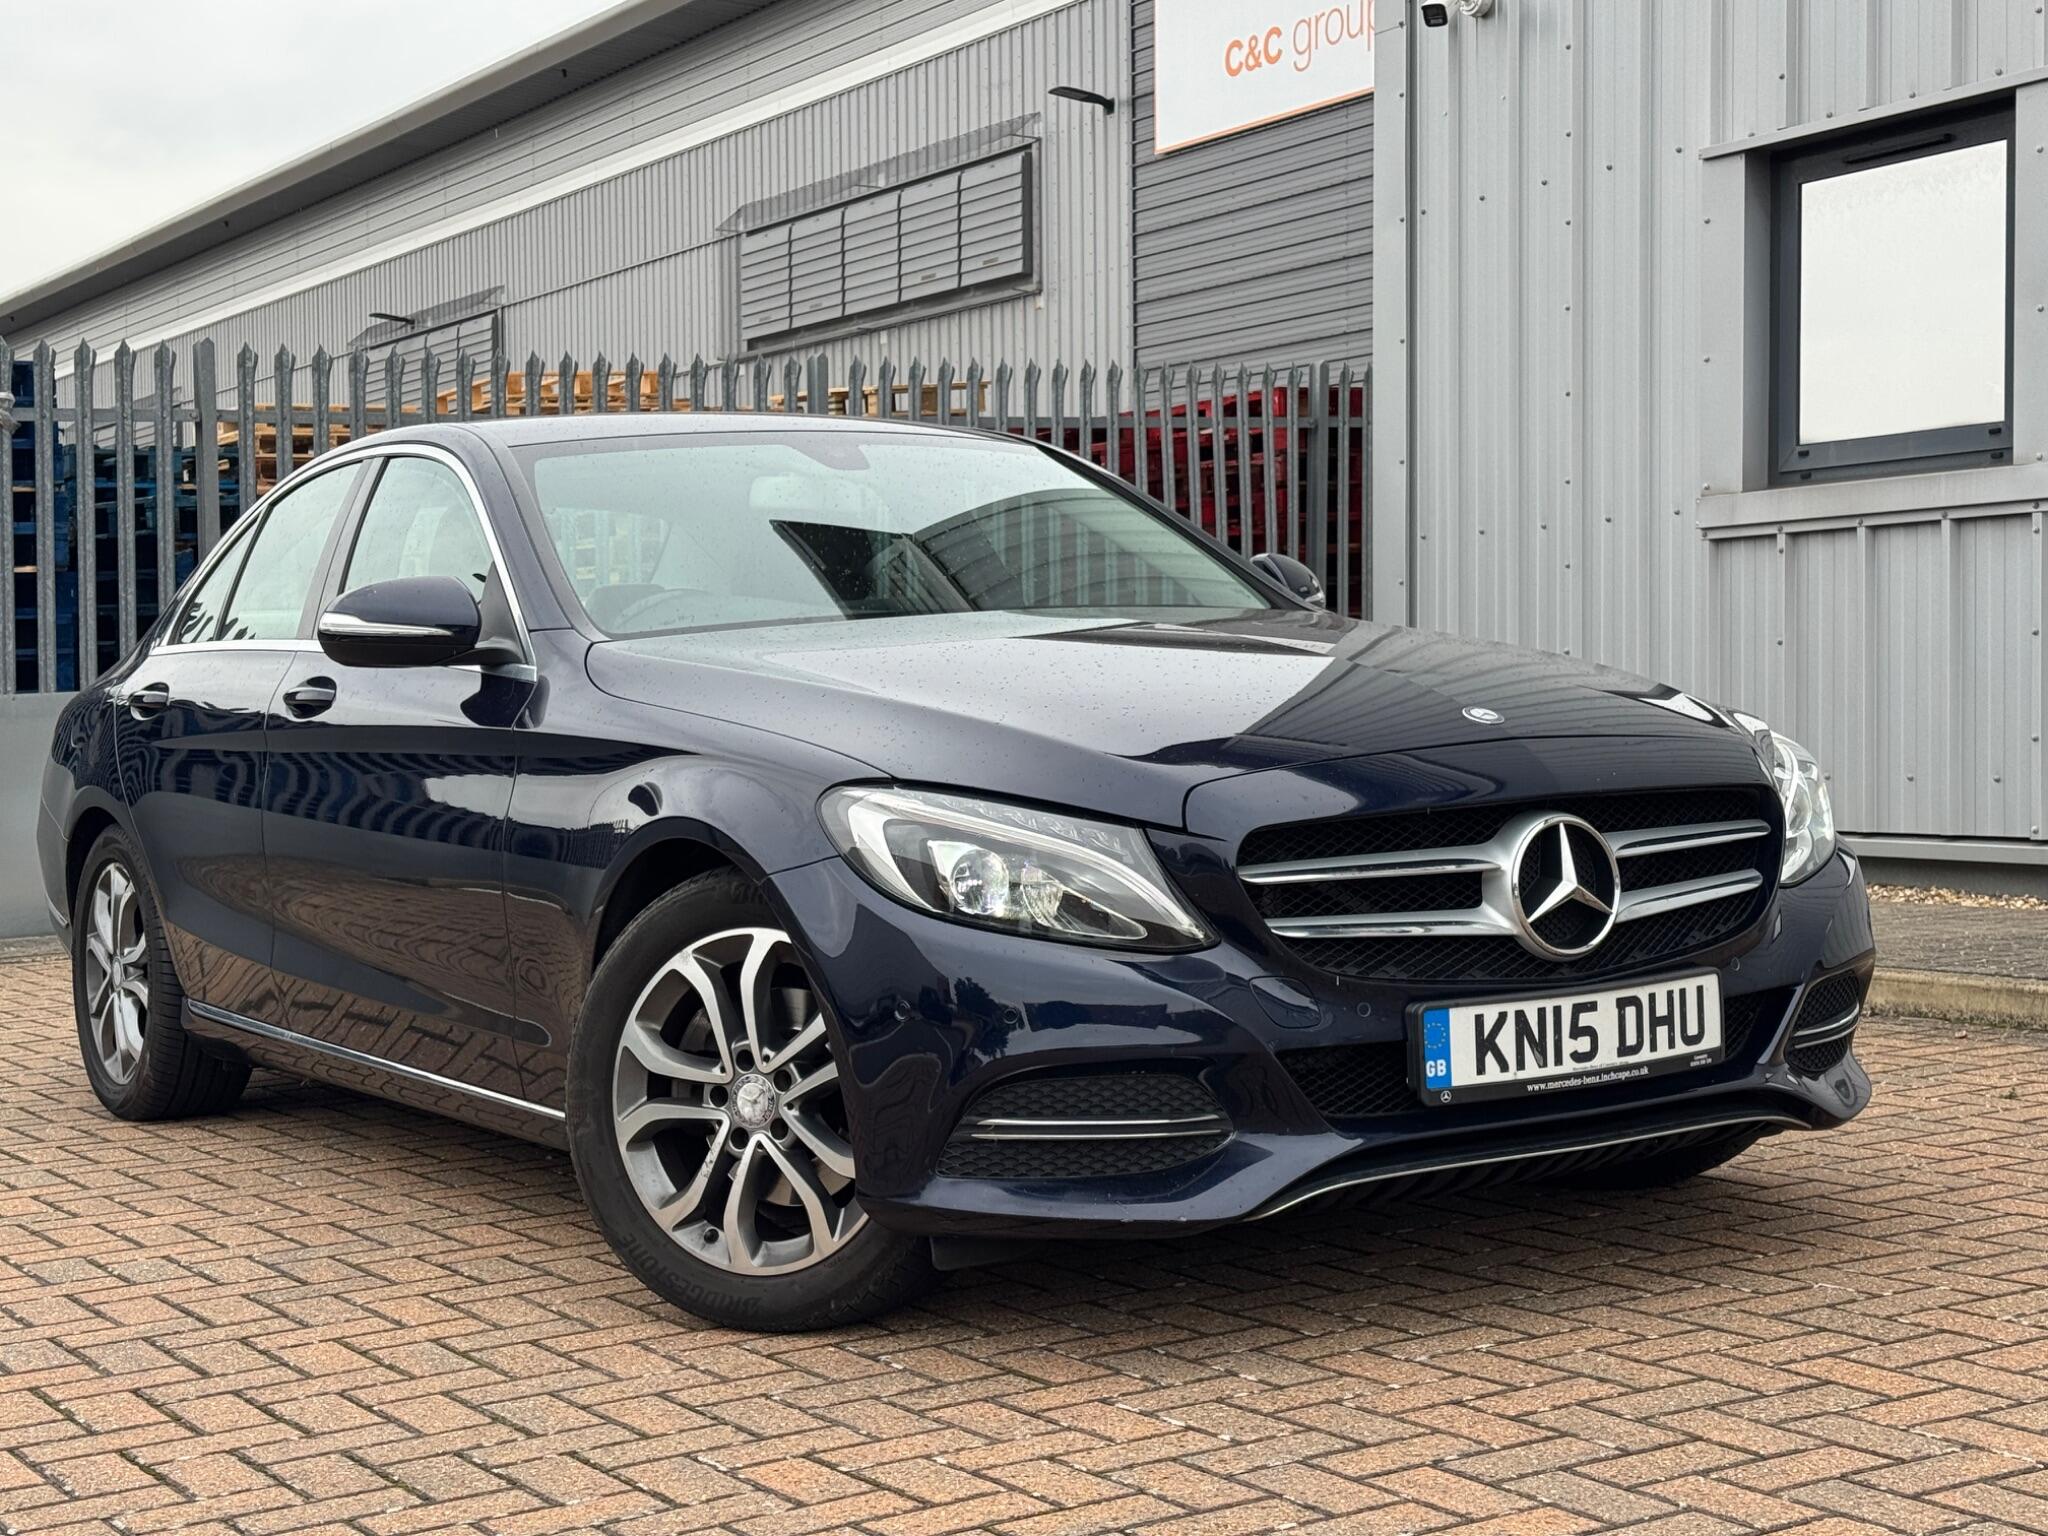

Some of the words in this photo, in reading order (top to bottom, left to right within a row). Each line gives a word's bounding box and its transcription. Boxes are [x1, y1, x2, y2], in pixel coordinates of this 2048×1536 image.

[1224, 26, 1283, 77] C&C
[1473, 1000, 1600, 1077] KN15
[1615, 984, 1706, 1058] DHU
[1426, 1059, 1447, 1078] GB
